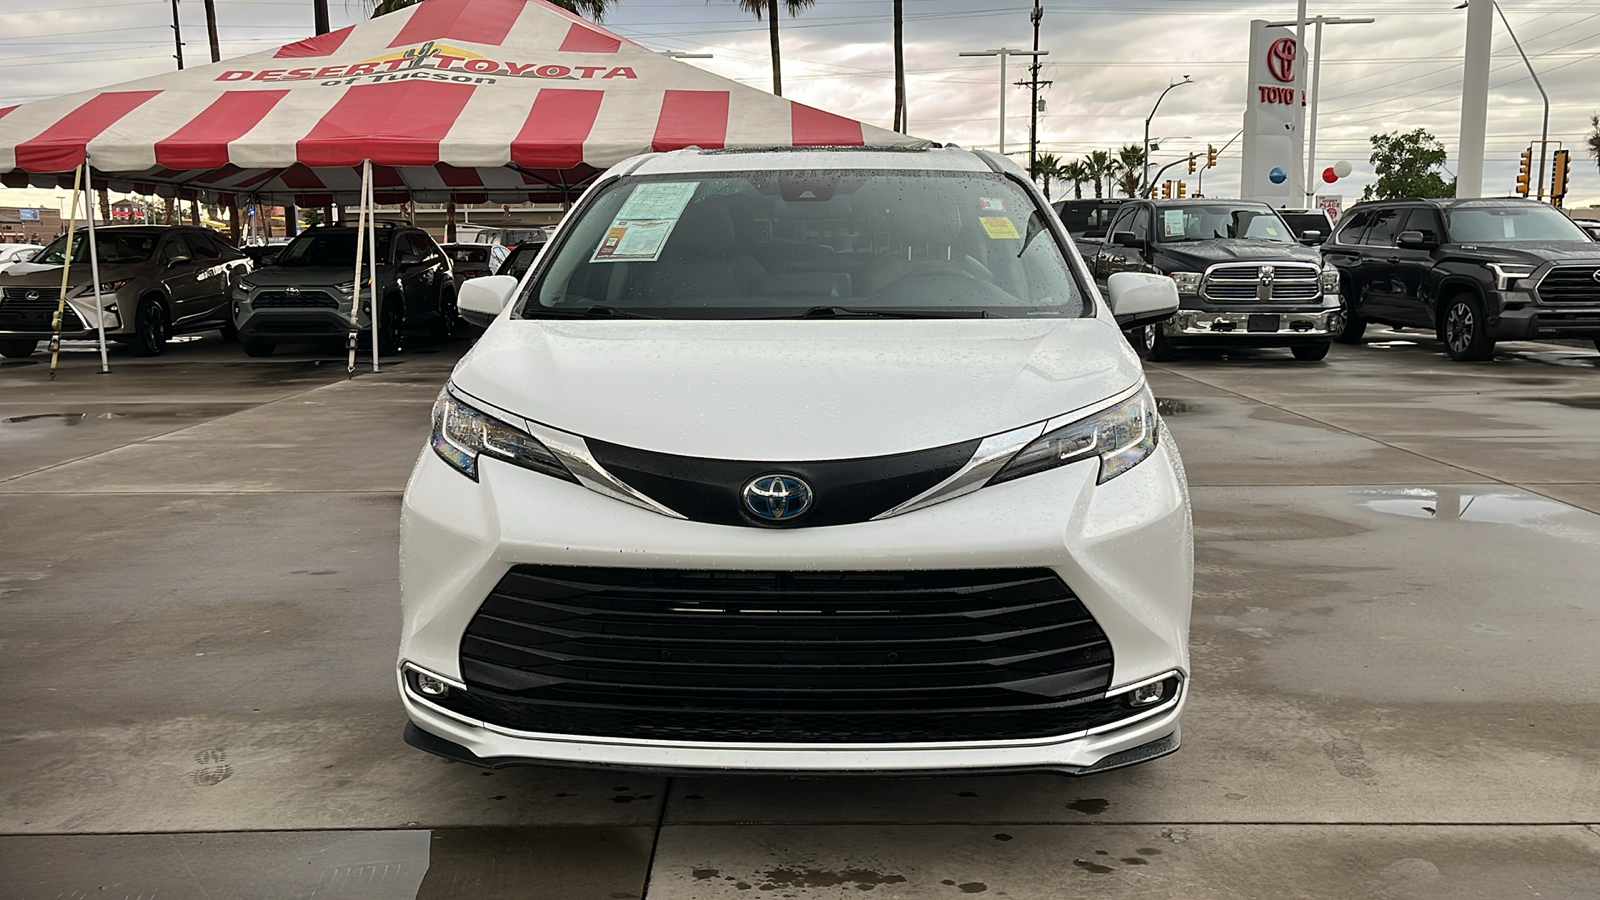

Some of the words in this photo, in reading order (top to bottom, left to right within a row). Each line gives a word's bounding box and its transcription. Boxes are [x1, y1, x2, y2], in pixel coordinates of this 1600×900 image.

[213, 56, 416, 82] DESERT
[432, 53, 639, 79] TOYOTA
[320, 76, 361, 87] of
[371, 71, 497, 85] Tucson
[1258, 85, 1307, 107] TOYO
